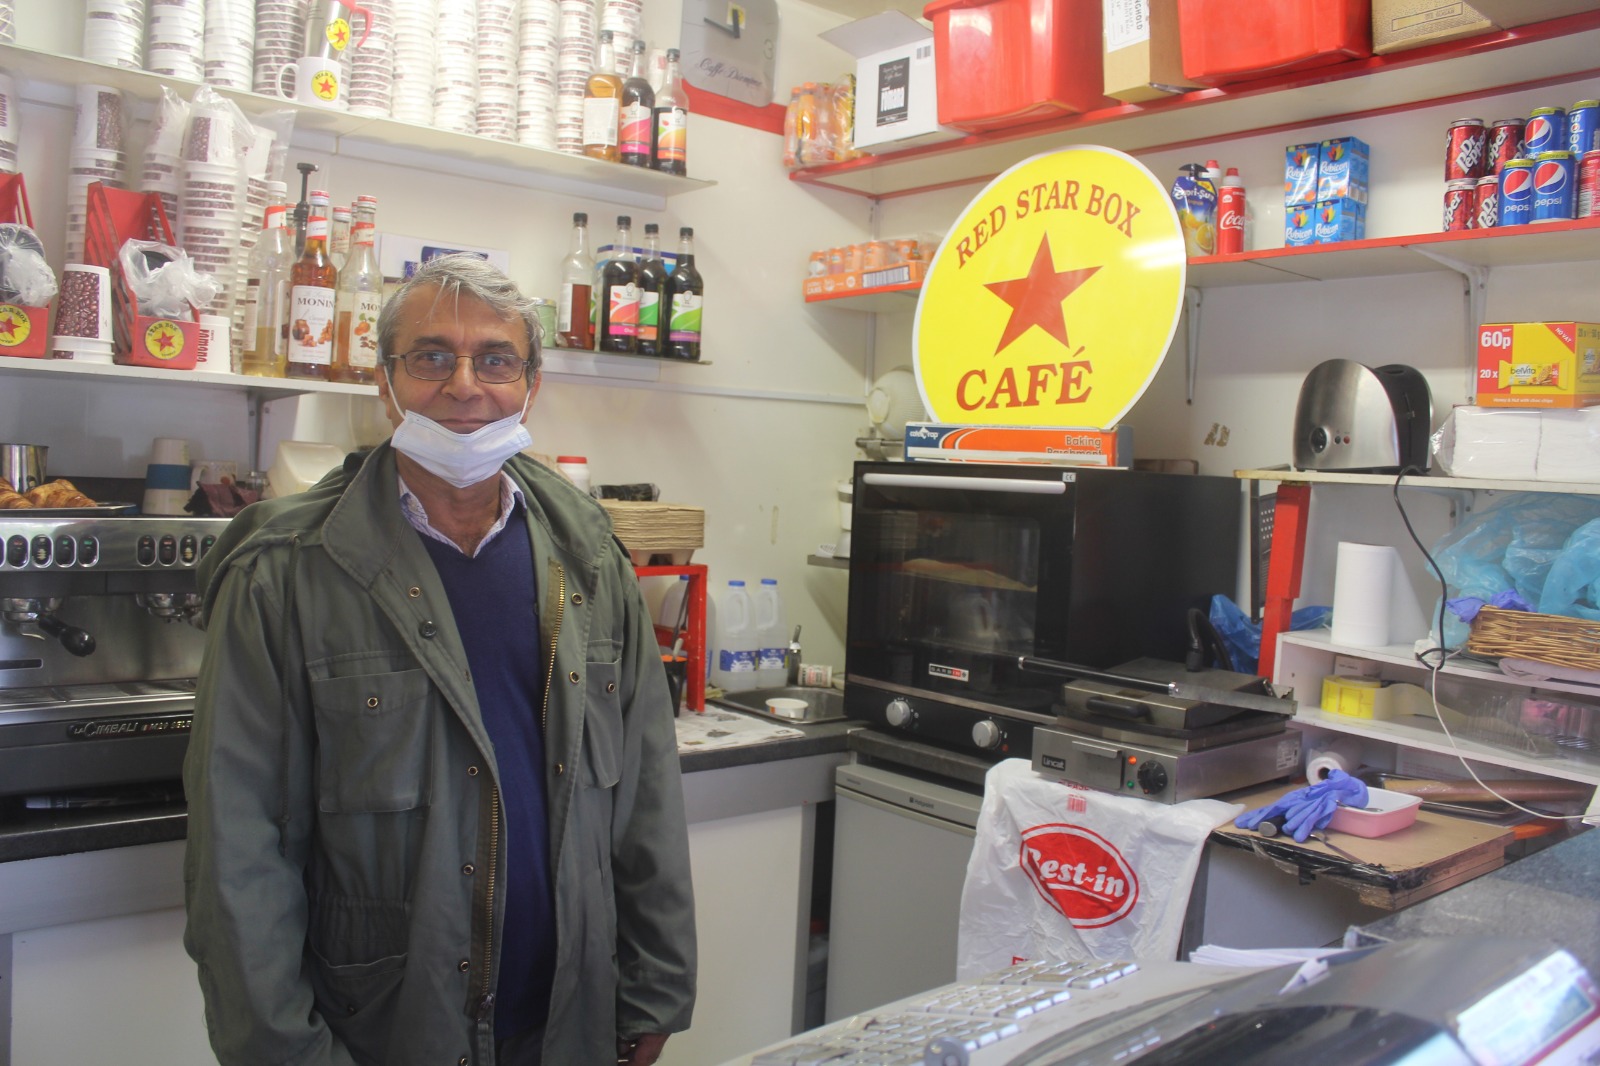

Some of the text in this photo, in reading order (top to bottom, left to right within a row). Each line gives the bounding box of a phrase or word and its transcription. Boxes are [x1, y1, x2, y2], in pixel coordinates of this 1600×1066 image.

[1569, 109, 1585, 154] pepsi
[1456, 131, 1487, 175] Pepper
[1460, 135, 1477, 154] Dr
[1488, 128, 1508, 171] pper
[1172, 185, 1215, 202] Cpri-Sun
[1443, 190, 1462, 232] pper
[1504, 203, 1530, 214] peps
[1534, 196, 1562, 209] pepsi
[955, 180, 1141, 270] RED STAR BOX
[1477, 207, 1498, 230] Pep
[297, 297, 334, 308] MONIN
[147, 323, 164, 336] STAR
[1481, 331, 1511, 349] 60p
[956, 346, 1093, 411] CAFÉ
[1480, 370, 1491, 379] 20
[1065, 434, 1101, 449] Baking
[85, 721, 139, 737] CIMBALI
[1043, 756, 1065, 769] Lincat
